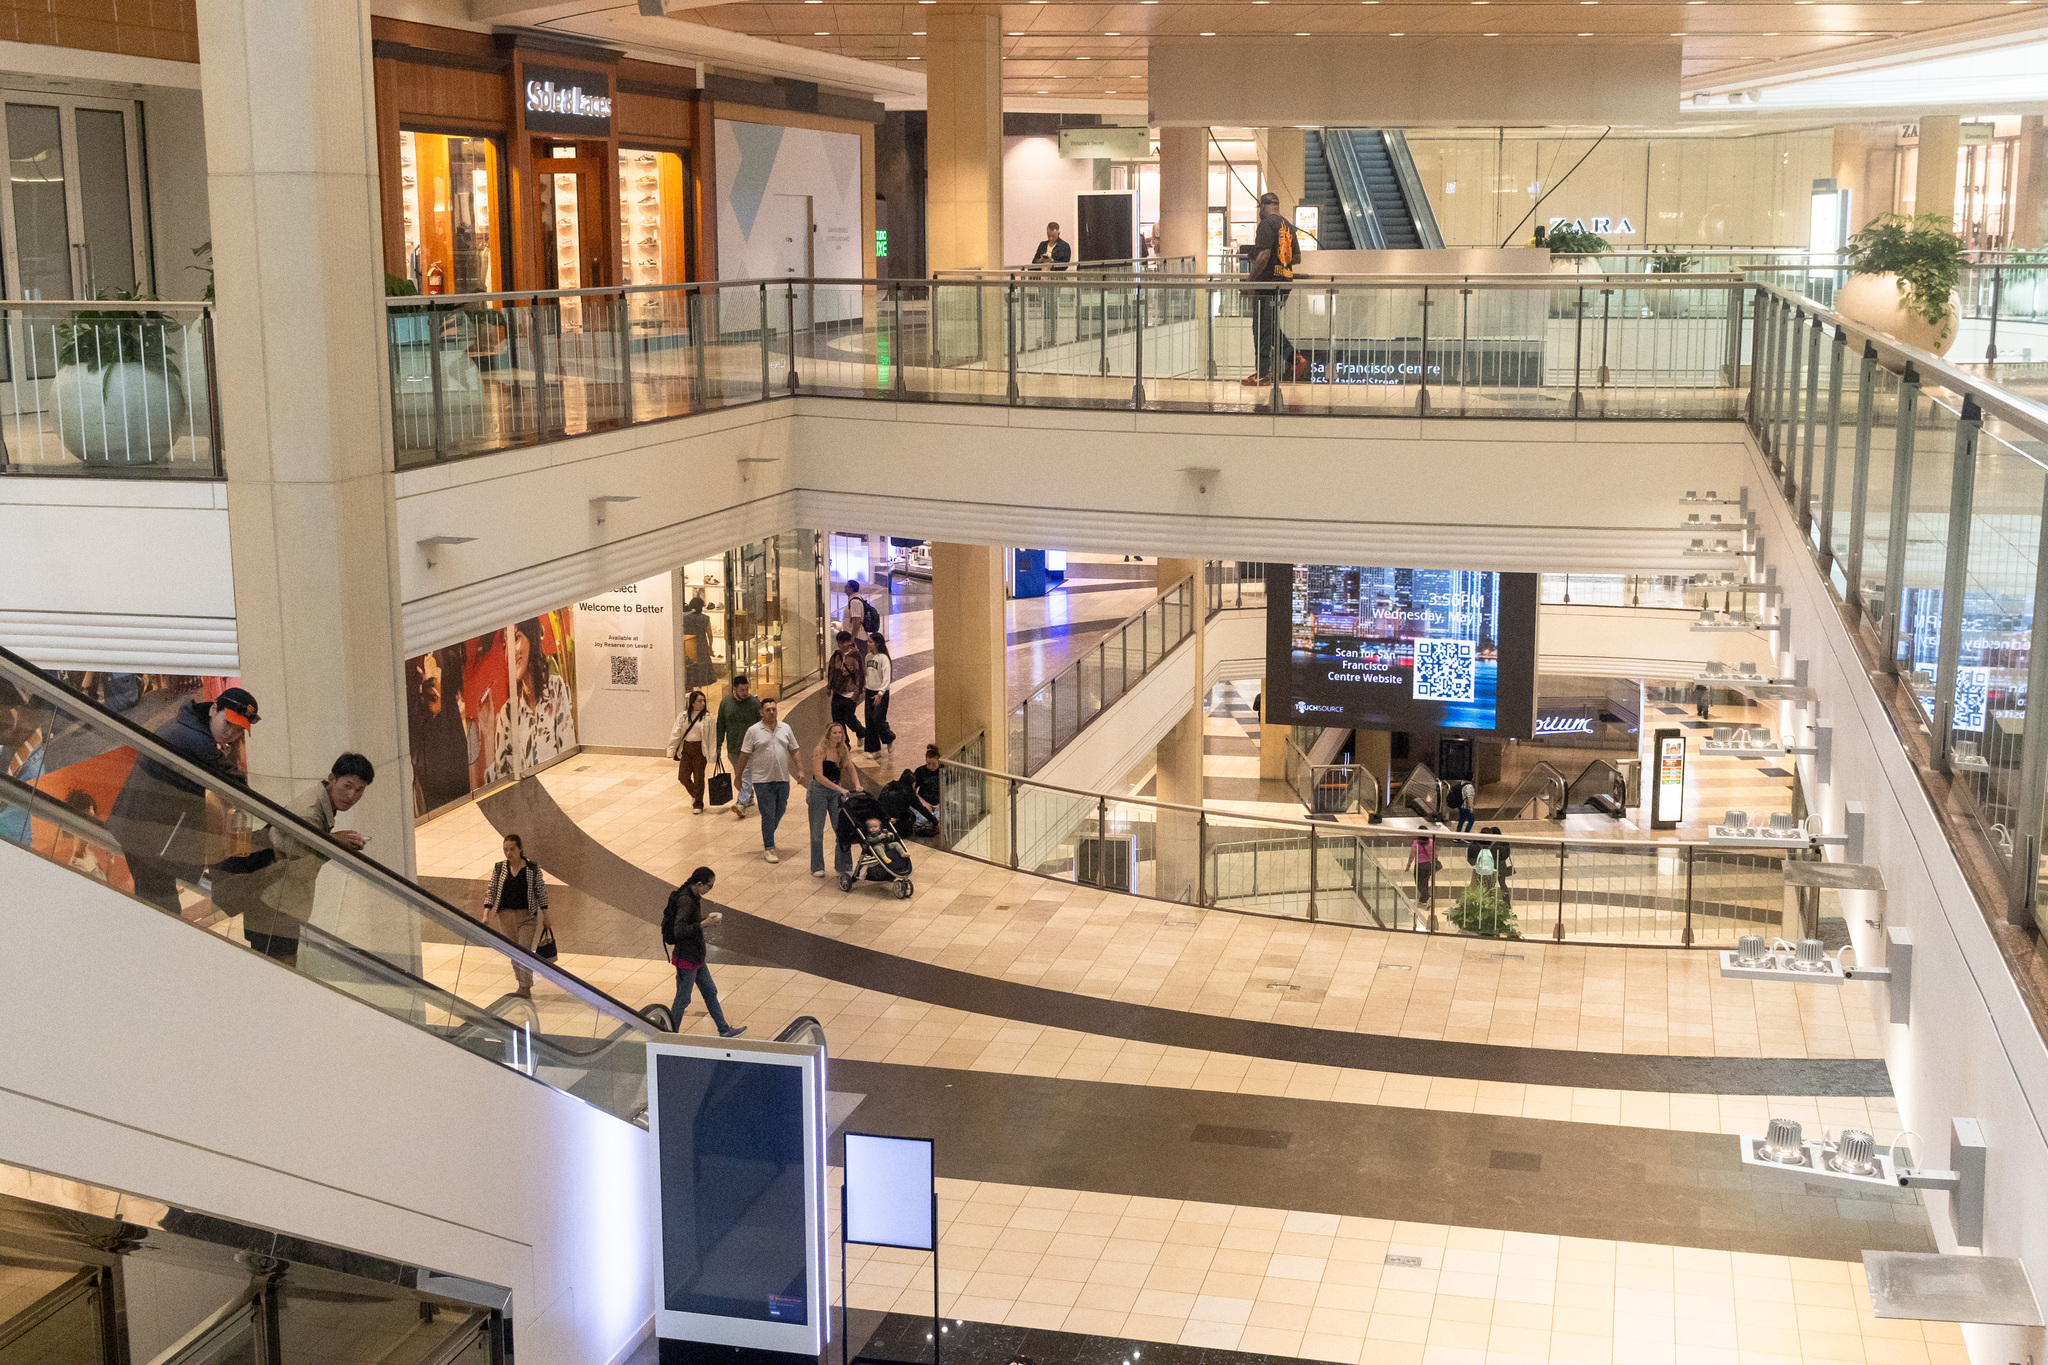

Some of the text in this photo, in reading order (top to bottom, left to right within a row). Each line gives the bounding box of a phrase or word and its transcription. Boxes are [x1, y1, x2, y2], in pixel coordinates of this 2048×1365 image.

[527, 80, 612, 117] Sole & Laces
[1902, 124, 1919, 138] ZA
[1549, 216, 1636, 234] ZARA
[1310, 362, 1441, 375] Sa Francisco Cenre
[579, 602, 664, 614] Welcome to Better
[1372, 608, 1445, 624] Wednesday,
[1335, 648, 1396, 660] Scan for San
[1342, 660, 1389, 671] Francisco
[1328, 671, 1403, 684] Centre Website
